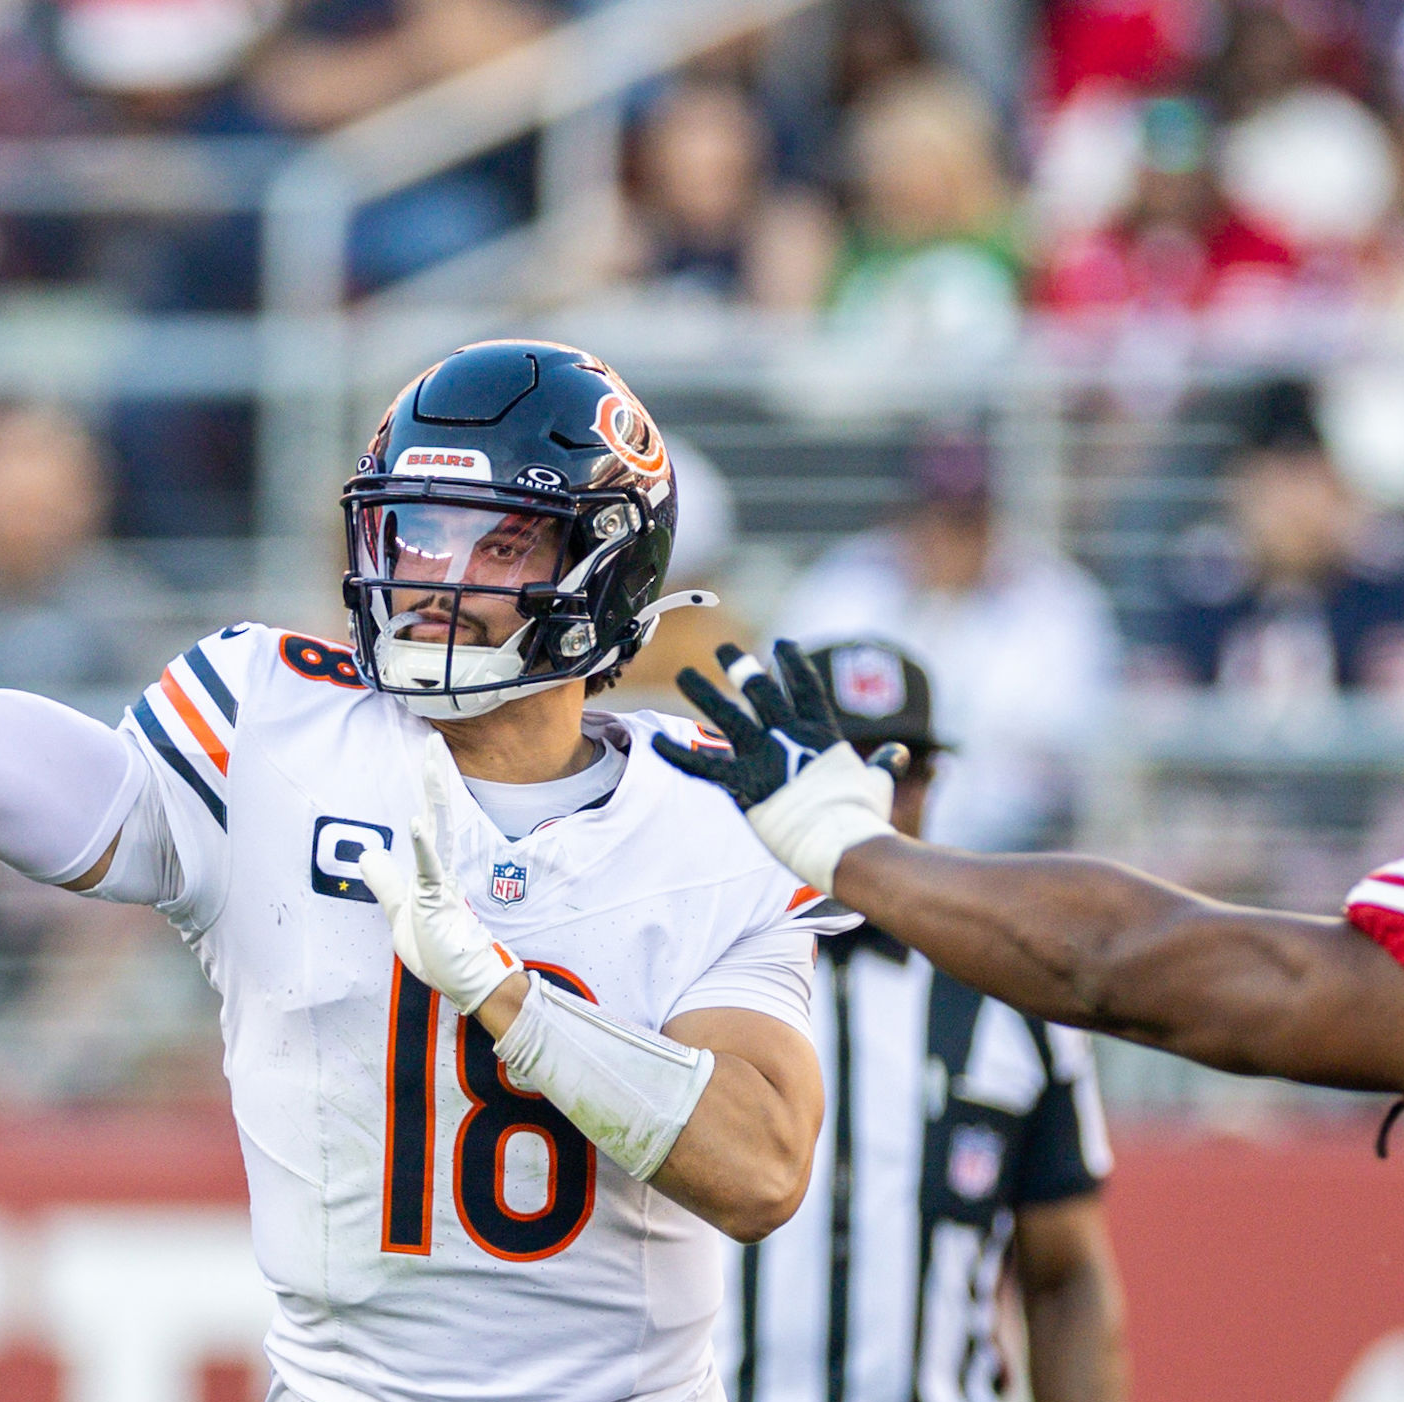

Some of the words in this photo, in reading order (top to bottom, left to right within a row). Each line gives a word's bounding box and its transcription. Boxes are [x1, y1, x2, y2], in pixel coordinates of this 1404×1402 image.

[406, 454, 475, 468] BEARS
[495, 879, 521, 899] NFL
[381, 957, 599, 1262] 18
